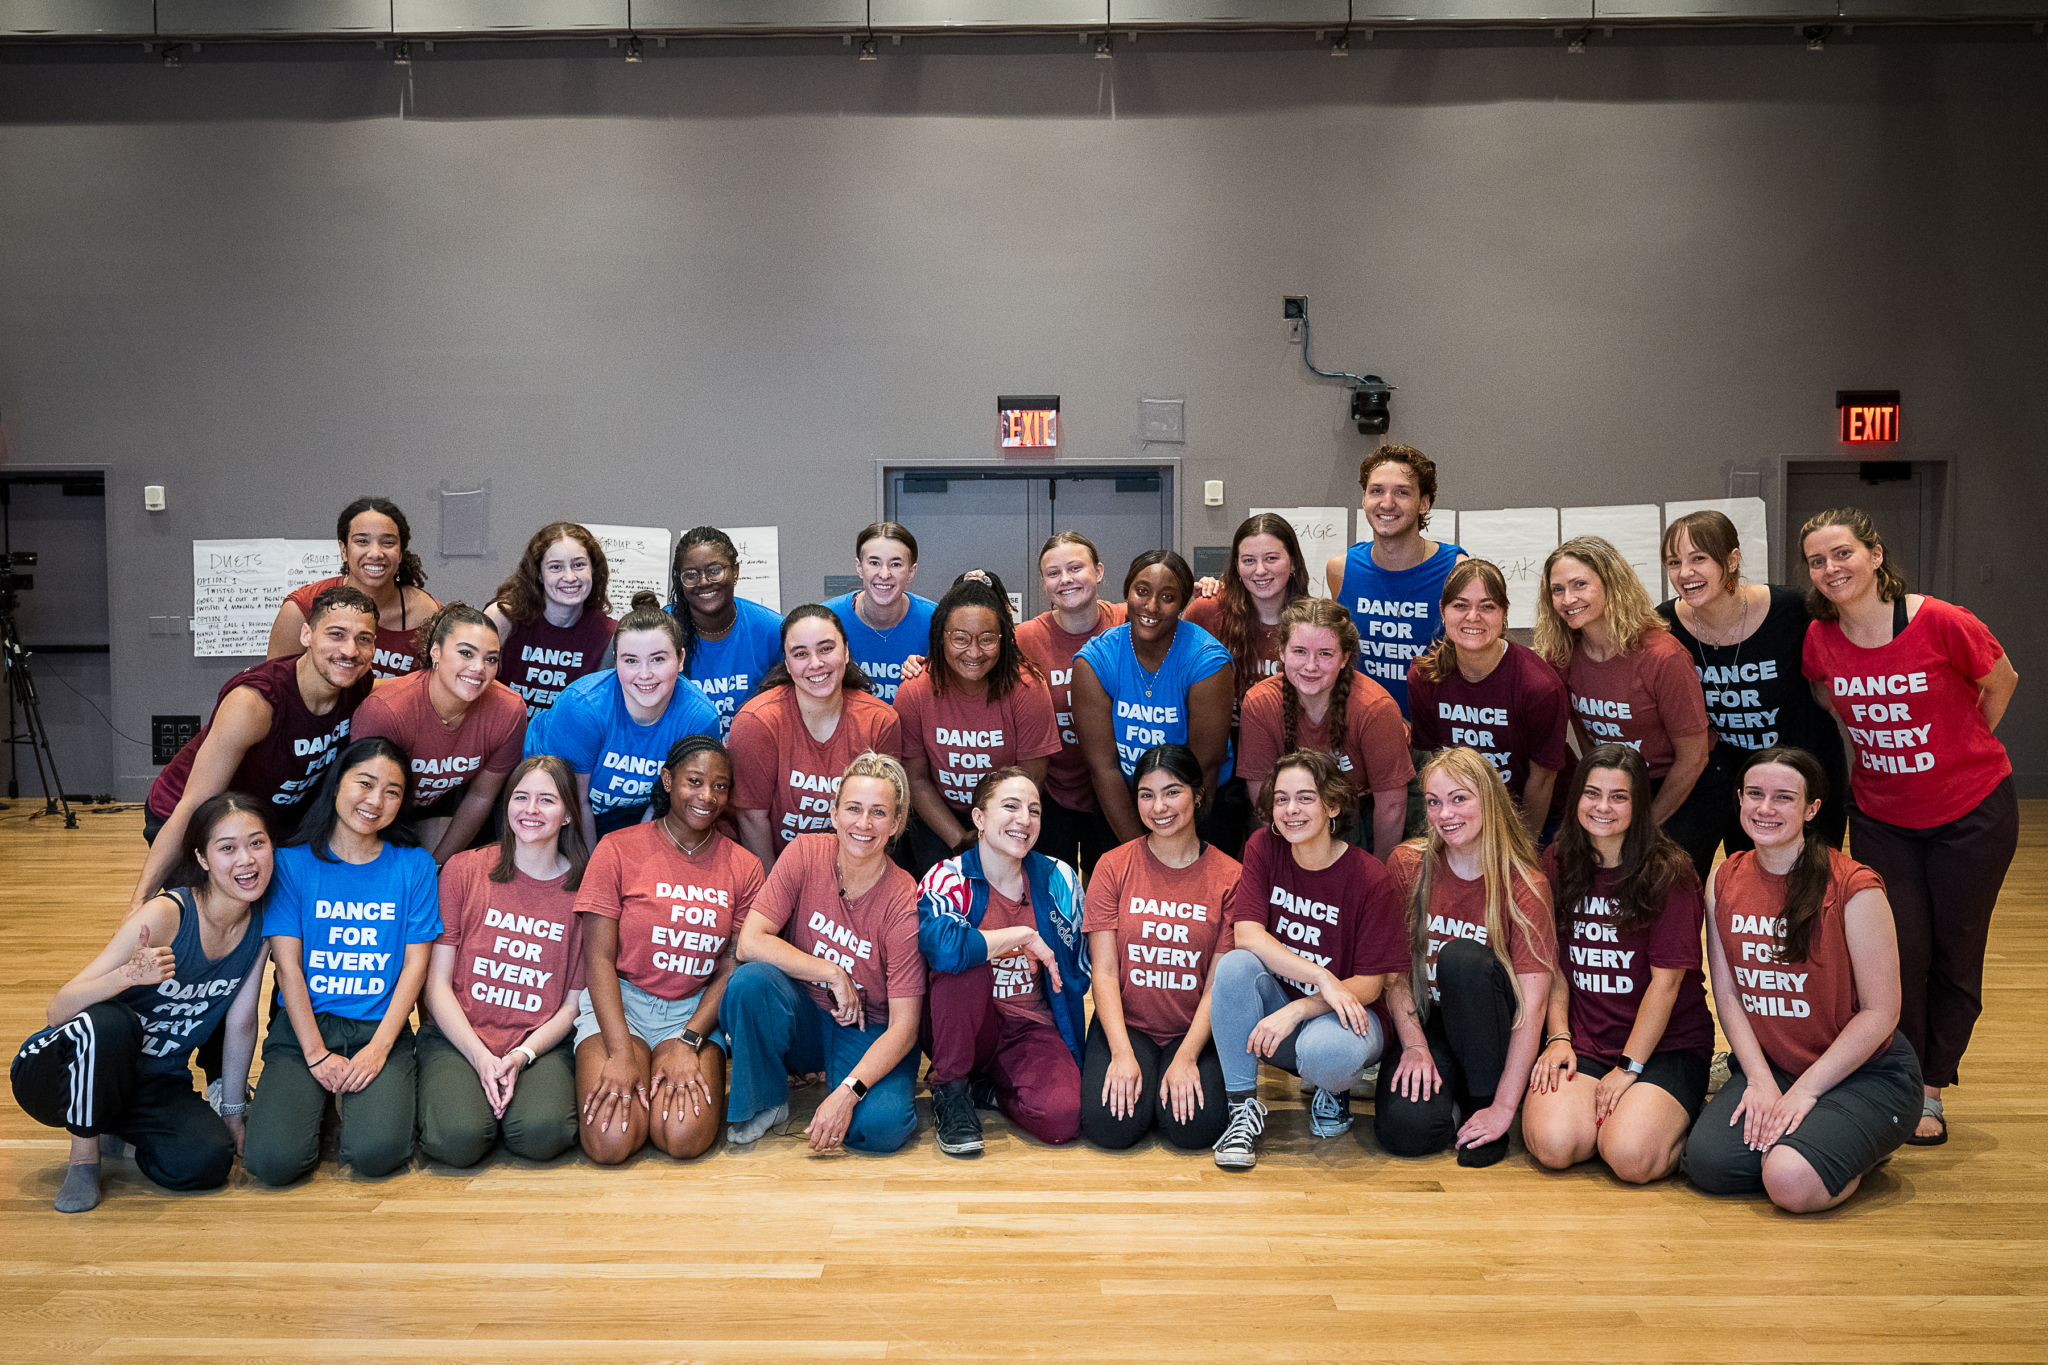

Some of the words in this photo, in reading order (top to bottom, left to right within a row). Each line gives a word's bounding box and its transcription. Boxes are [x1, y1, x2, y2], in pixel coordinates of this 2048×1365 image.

[1009, 412, 1051, 446] EXIT
[1850, 408, 1894, 440] EXIT
[636, 541, 645, 550] 3
[739, 542, 748, 554] 4
[210, 553, 262, 569] DUETS
[301, 552, 330, 565] GROUP
[196, 577, 227, 586] OPTION
[204, 588, 235, 596] TWISTED
[262, 586, 283, 594] THAT
[196, 596, 214, 605] GOES
[218, 596, 225, 604] IN
[1357, 597, 1428, 618] DANCE
[196, 615, 220, 623] OPTION
[1369, 620, 1413, 639] FOR
[372, 648, 414, 671] NCE
[521, 645, 584, 668] DANCE
[1358, 639, 1427, 660] EVERY
[526, 666, 566, 686] FOR
[860, 662, 904, 679] ANC
[1364, 660, 1408, 680] CHIL
[1834, 672, 1928, 696] DANCE
[1571, 692, 1632, 720] DANCE
[1706, 690, 1762, 708] FOR
[1117, 700, 1178, 724] DANCE
[1438, 702, 1508, 726] DANCE
[1851, 702, 1912, 722] FOR
[936, 727, 1004, 748] DANCE
[1126, 725, 1166, 746] FOR
[1452, 727, 1496, 748] FOR
[1582, 718, 1624, 738] FOR
[1848, 722, 1932, 748] EVERY
[305, 747, 338, 776] FOR
[411, 756, 482, 774] DANCE
[949, 752, 992, 768] FOR
[1862, 750, 1935, 774] CHILD
[418, 776, 464, 788] FOR
[608, 775, 654, 796] FOR
[790, 770, 842, 794] DANC
[782, 812, 834, 830] EVER
[656, 882, 728, 908] DANCE
[1270, 886, 1340, 926] DANCE
[316, 900, 396, 920] DANCE
[670, 904, 717, 928] FOR
[1130, 896, 1207, 922] DANCE
[328, 926, 378, 946] FOR
[484, 908, 565, 942] DANCE
[808, 910, 872, 960] DANCE
[1142, 920, 1189, 944] FOR
[1276, 916, 1322, 946] FOR
[1731, 914, 1788, 938] DANC
[493, 936, 543, 962] FOR
[651, 926, 726, 953] EVERY
[309, 950, 391, 970] EVERY
[652, 951, 715, 976] CHILD
[812, 940, 855, 974] FOR
[1128, 944, 1202, 968] EVERY
[472, 956, 553, 989] EVERY
[1130, 968, 1198, 990] CHILD
[1734, 966, 1808, 992] EVERY
[156, 978, 242, 1000] DANCE
[310, 974, 385, 995] CHILD
[471, 982, 542, 1012] CHILD
[1742, 993, 1810, 1018] CHILD
